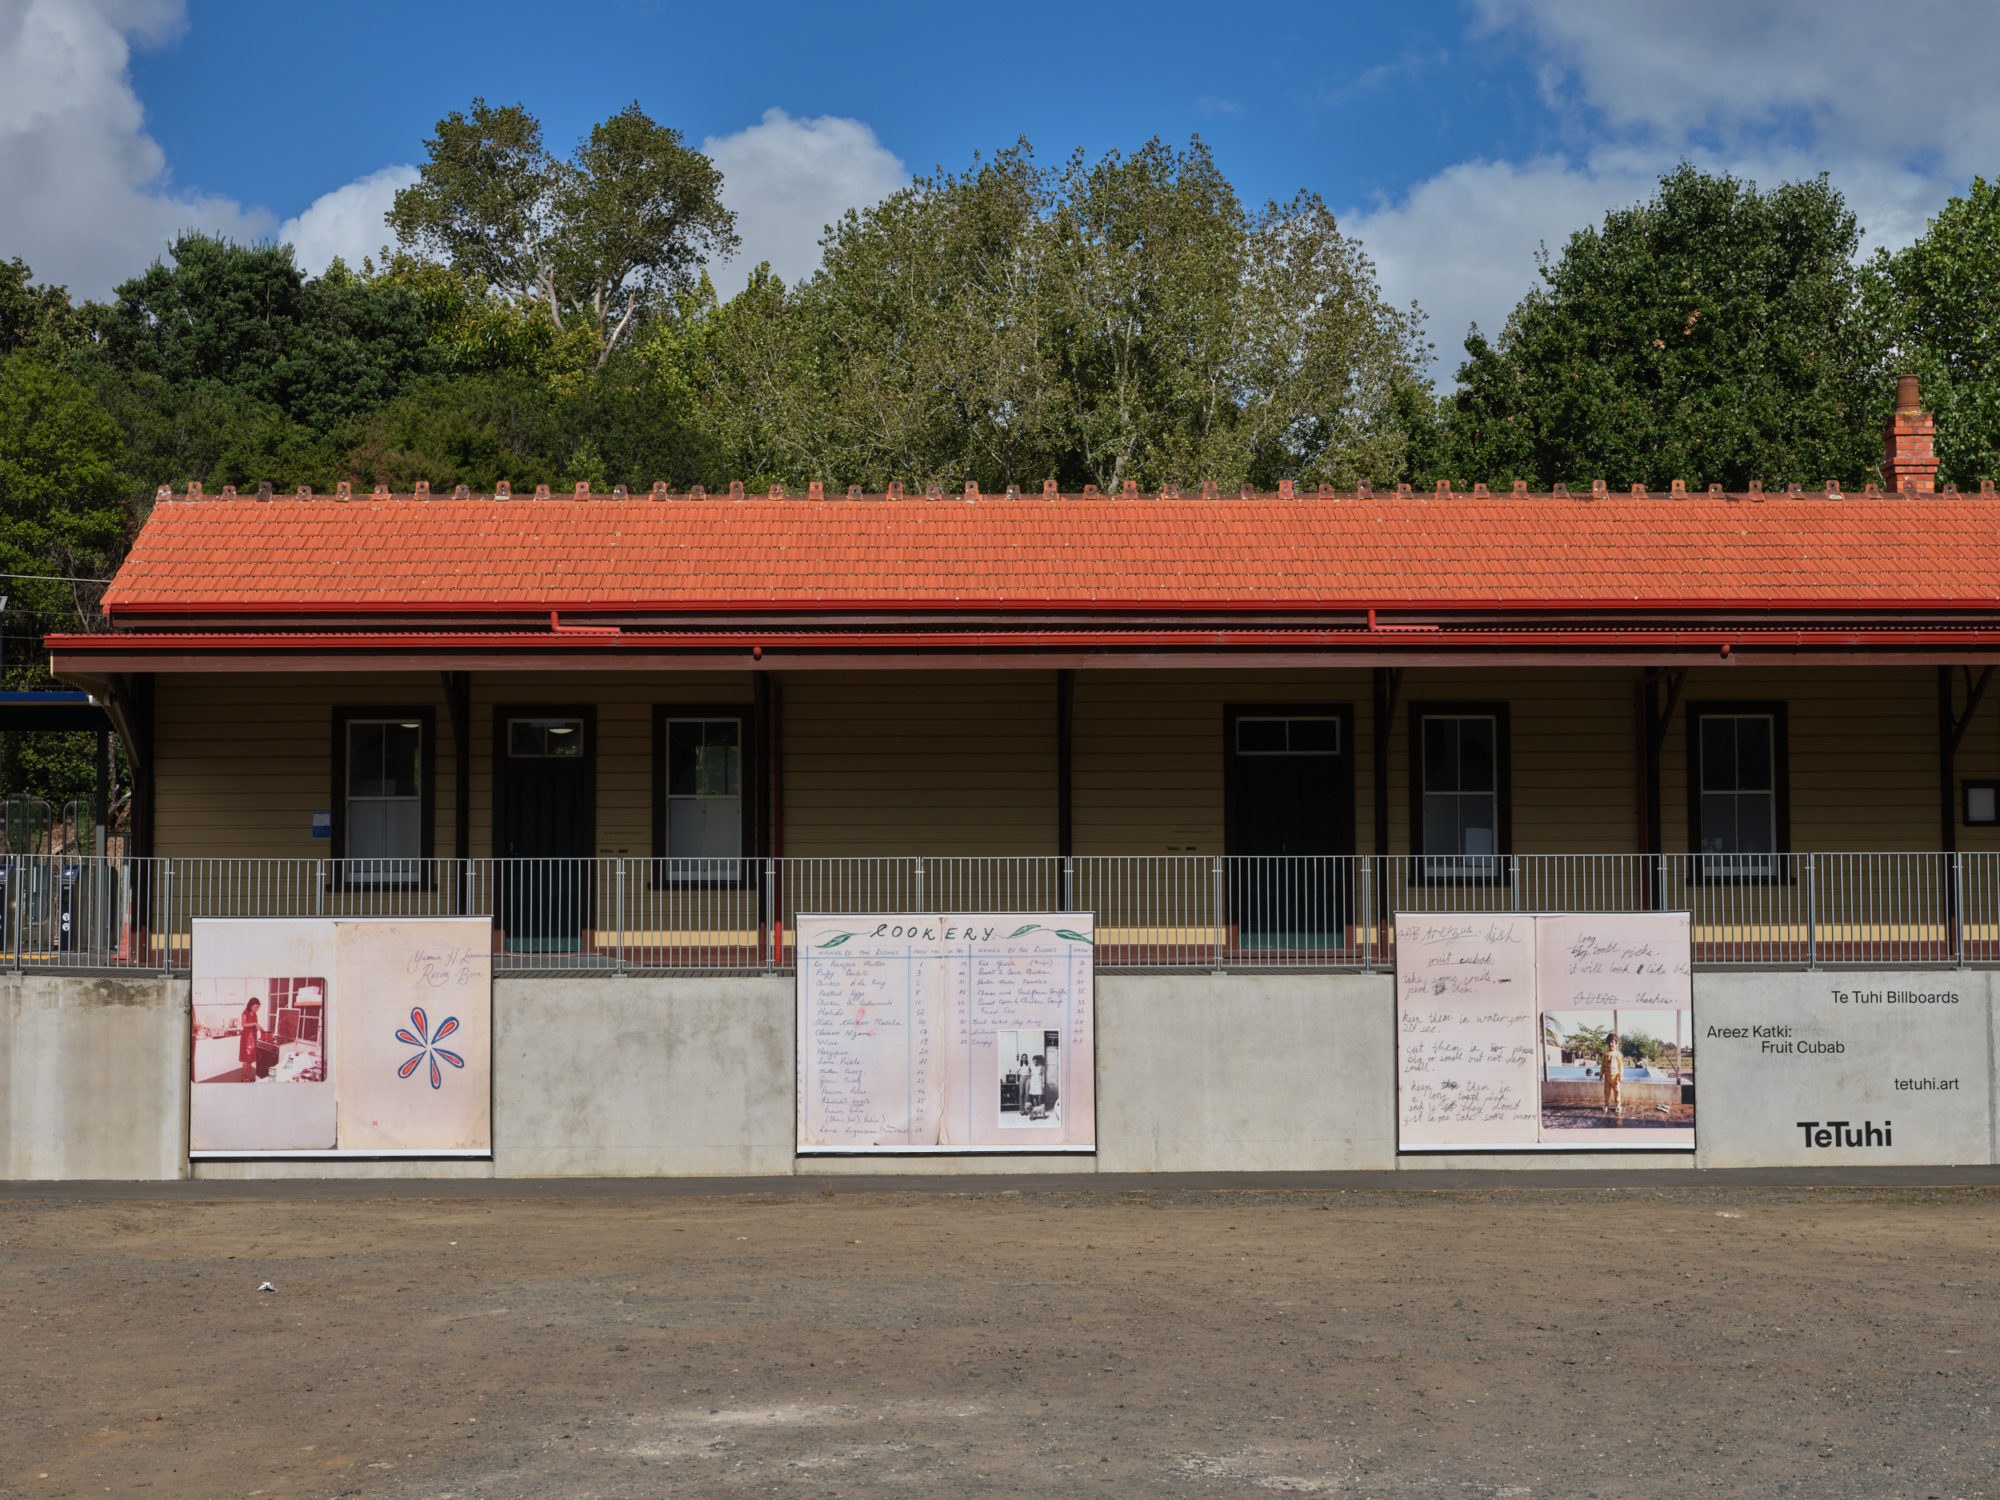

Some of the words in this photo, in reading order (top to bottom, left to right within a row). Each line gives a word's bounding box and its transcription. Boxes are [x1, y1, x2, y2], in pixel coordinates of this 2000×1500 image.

[1831, 991, 1848, 1004] Te
[1852, 991, 1883, 1004] Tuhi
[1887, 991, 1959, 1004] Billboards
[1707, 1026, 1749, 1038] Areez
[1753, 1025, 1792, 1038] Katki:
[1762, 1041, 1793, 1053] Fruit
[1797, 1041, 1845, 1053] Cubab
[1895, 1077, 1959, 1090] tetuhi.art
[1797, 1120, 1892, 1147] TeTuhi
